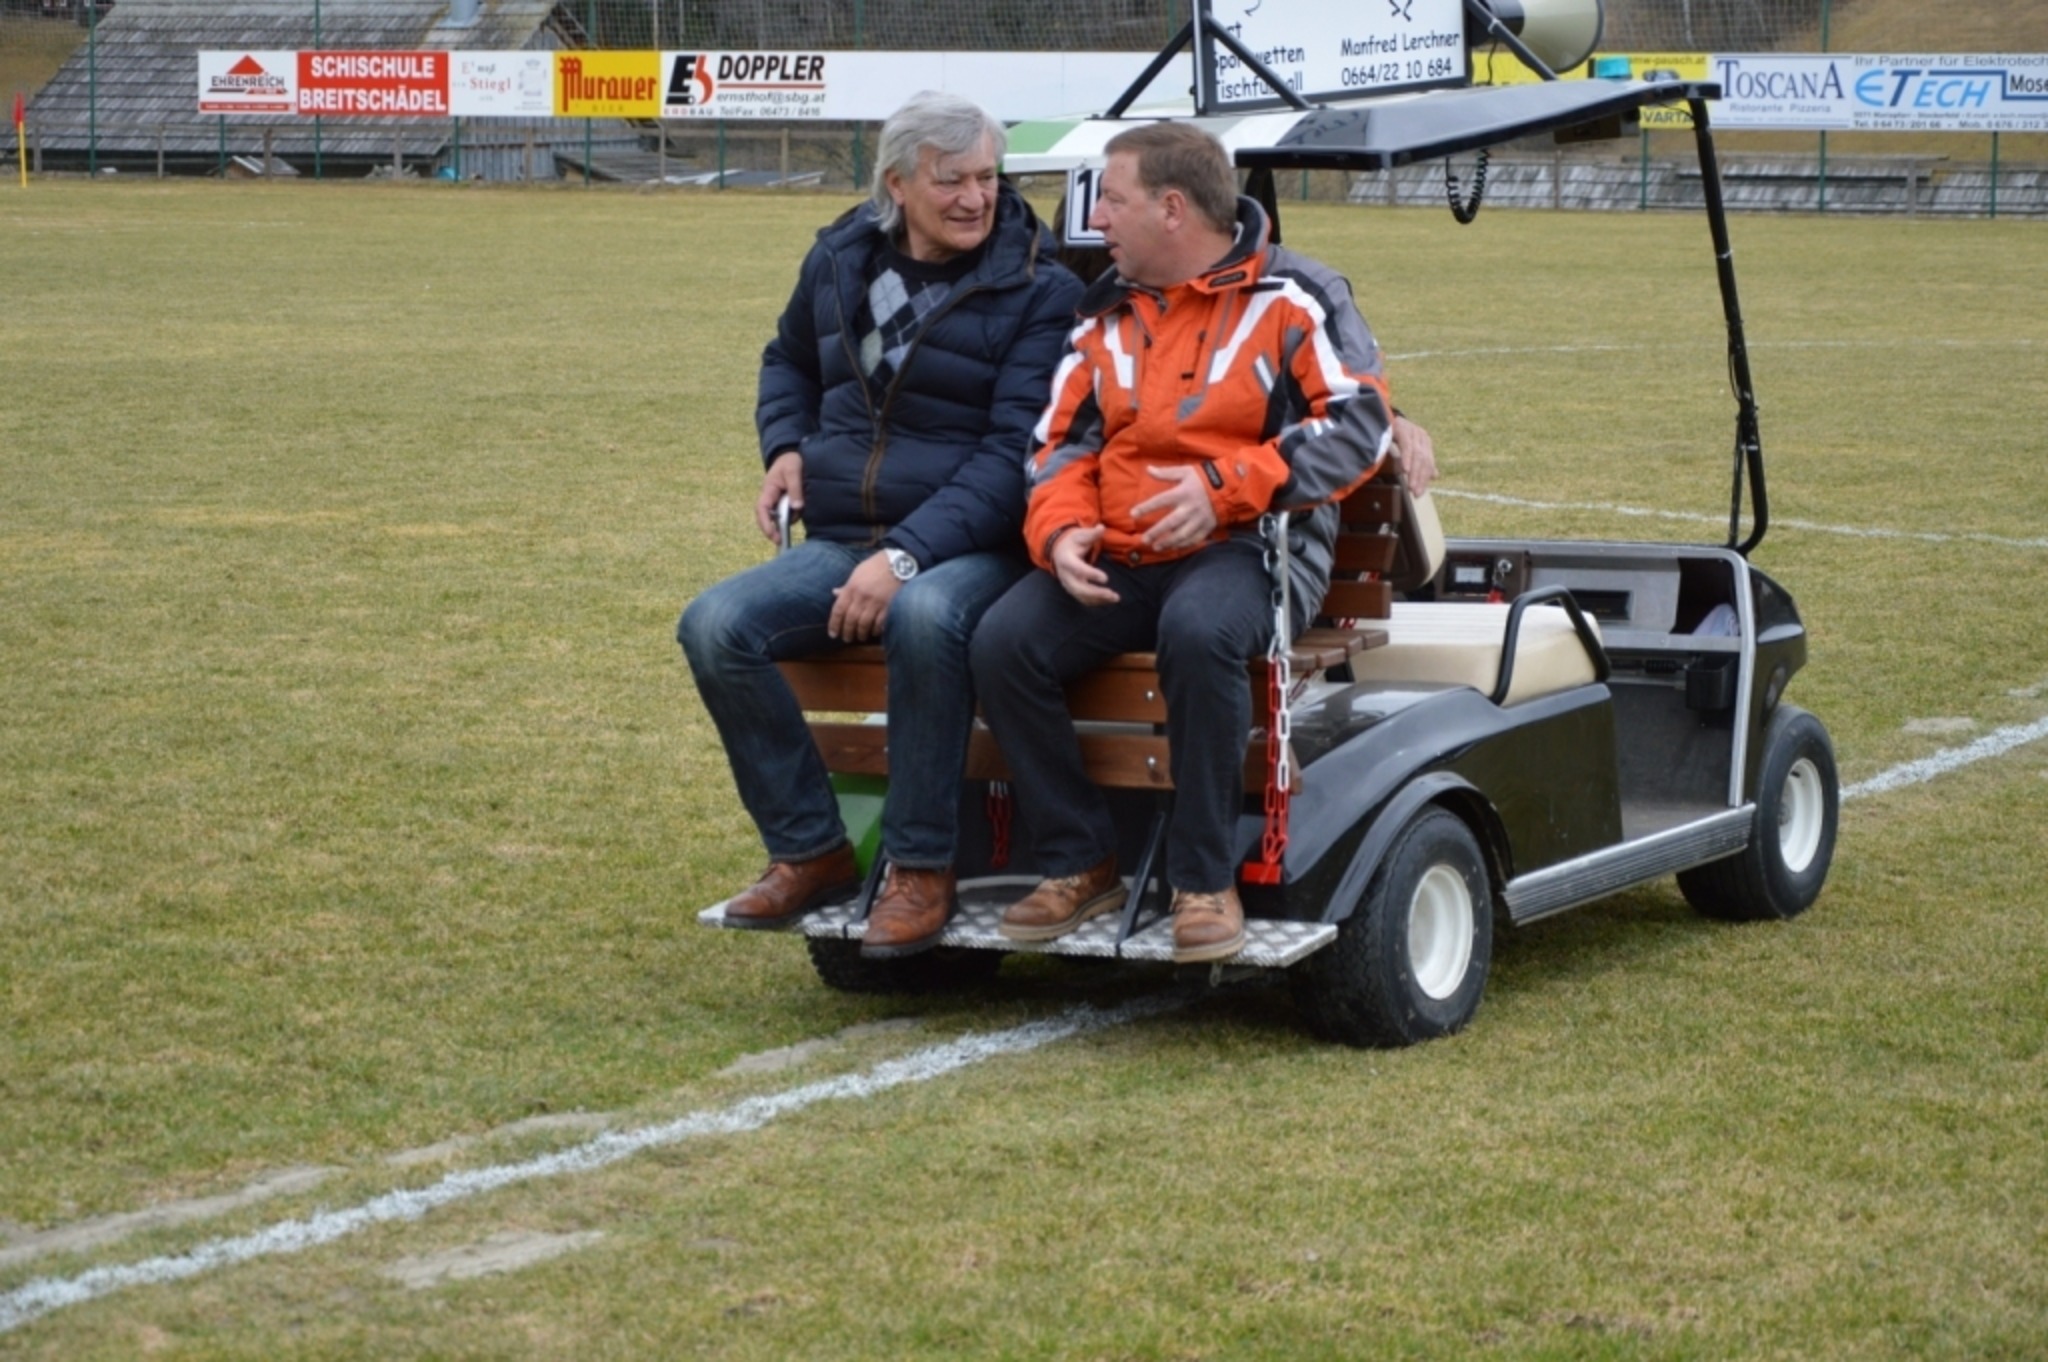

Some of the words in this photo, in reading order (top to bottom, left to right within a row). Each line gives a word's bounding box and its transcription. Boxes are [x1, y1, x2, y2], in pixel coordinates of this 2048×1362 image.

[1341, 33, 1397, 56] Manfred
[1403, 29, 1460, 52] Lerchner
[311, 55, 435, 79] SCHISCHULE
[717, 54, 825, 81] DOPPLER
[1341, 62, 1399, 87] 0664/22
[1406, 59, 1423, 79] 10
[1428, 56, 1452, 77] 684
[1855, 55, 1874, 66] Ihr
[1879, 55, 1935, 67] Partner
[1940, 54, 1957, 66] für
[211, 75, 285, 87] EHRENREICH
[469, 76, 511, 94] Stiegl
[559, 56, 657, 112] Murauer
[300, 84, 446, 111] BREITSCHÄDEL
[1730, 103, 1783, 113] Ristorante
[1790, 103, 1831, 113] Pizzeria
[1077, 169, 1104, 232] 1
